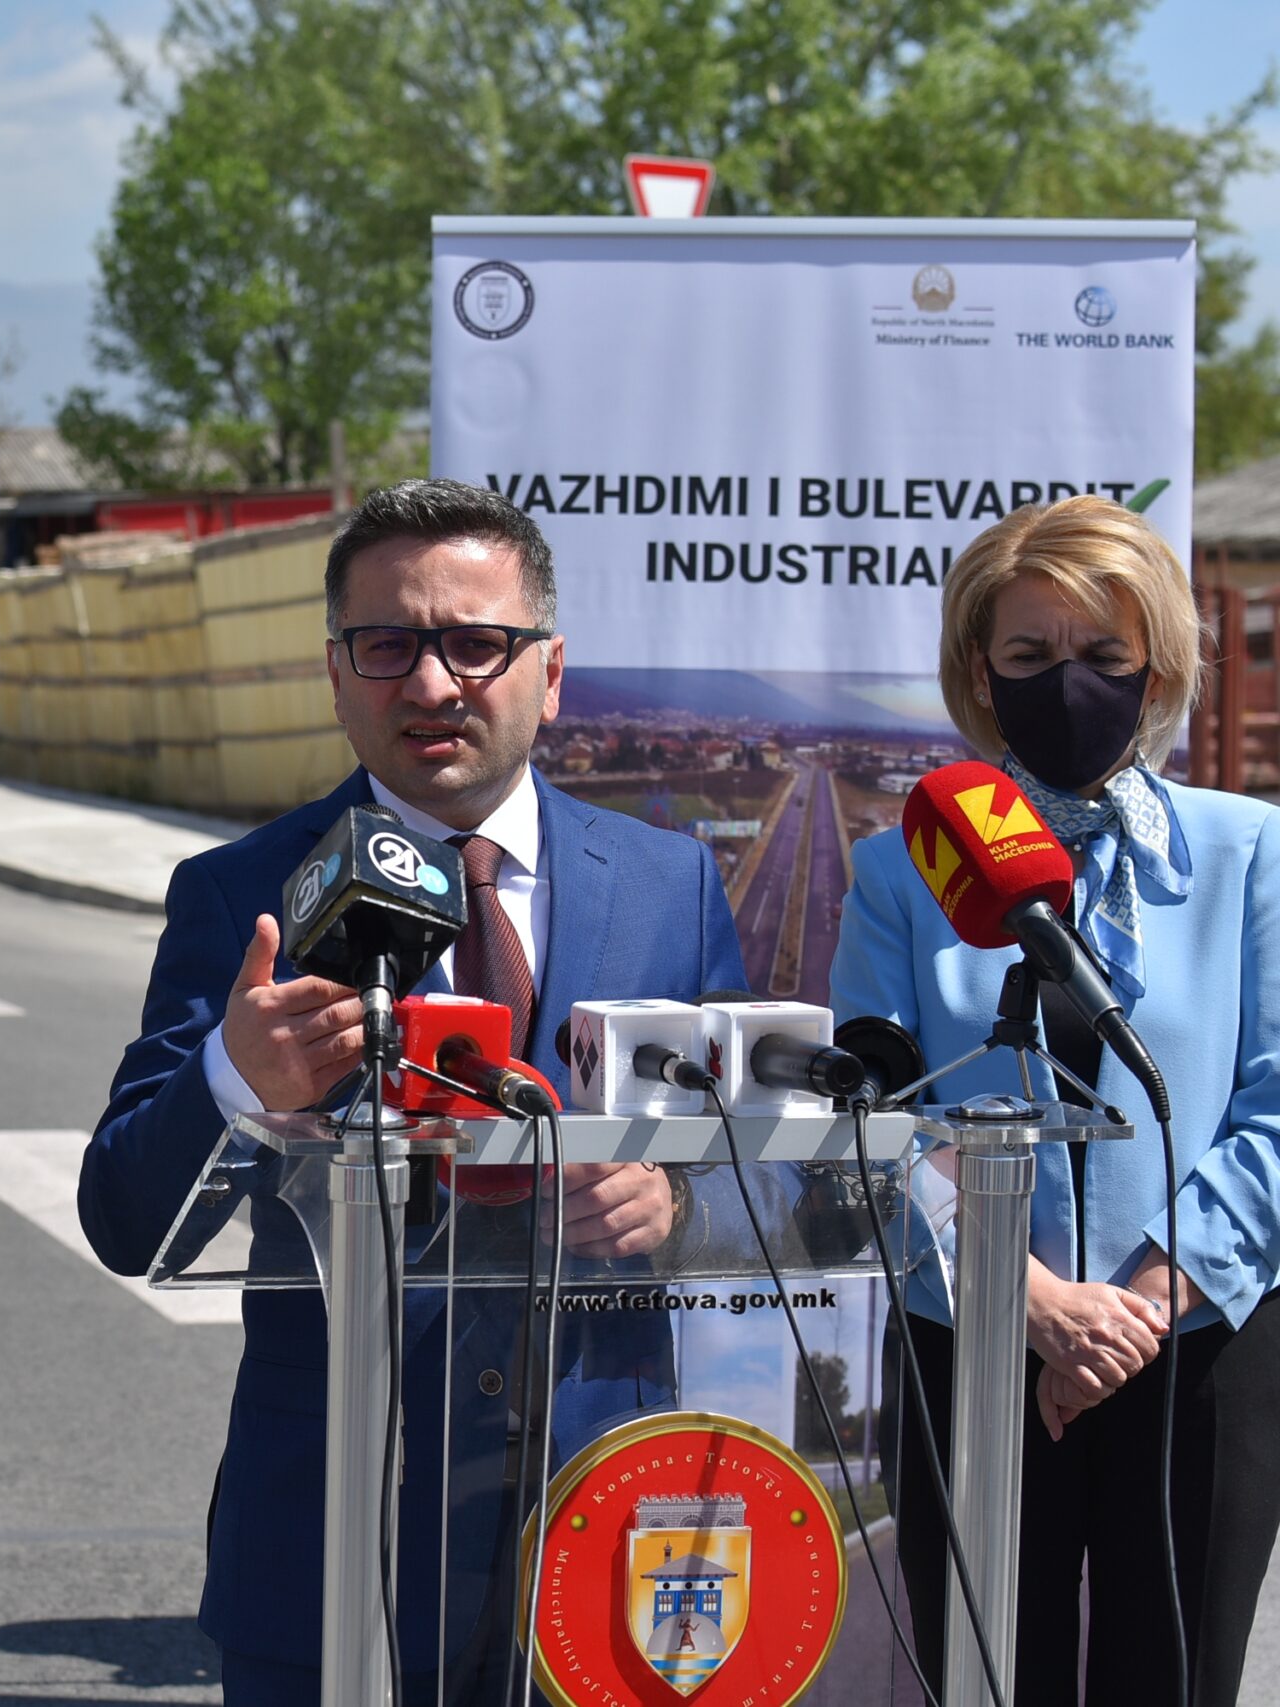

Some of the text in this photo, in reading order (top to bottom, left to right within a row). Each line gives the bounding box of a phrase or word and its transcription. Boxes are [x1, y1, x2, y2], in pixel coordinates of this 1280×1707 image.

[876, 334, 925, 347] Ministry
[942, 335, 990, 346] Finance
[1016, 333, 1175, 349] THE WORLD BANK
[486, 474, 749, 517] VAZHDIMI
[770, 477, 780, 516] I
[378, 840, 416, 882] 21
[988, 839, 1018, 856] KLAN
[993, 841, 1055, 864] MACEDONIA
[592, 1452, 783, 1504] Komuna e Tetovës
[801, 1534, 821, 1631] Тетово
[551, 1549, 581, 1672] Municipality
[582, 1676, 601, 1692] of
